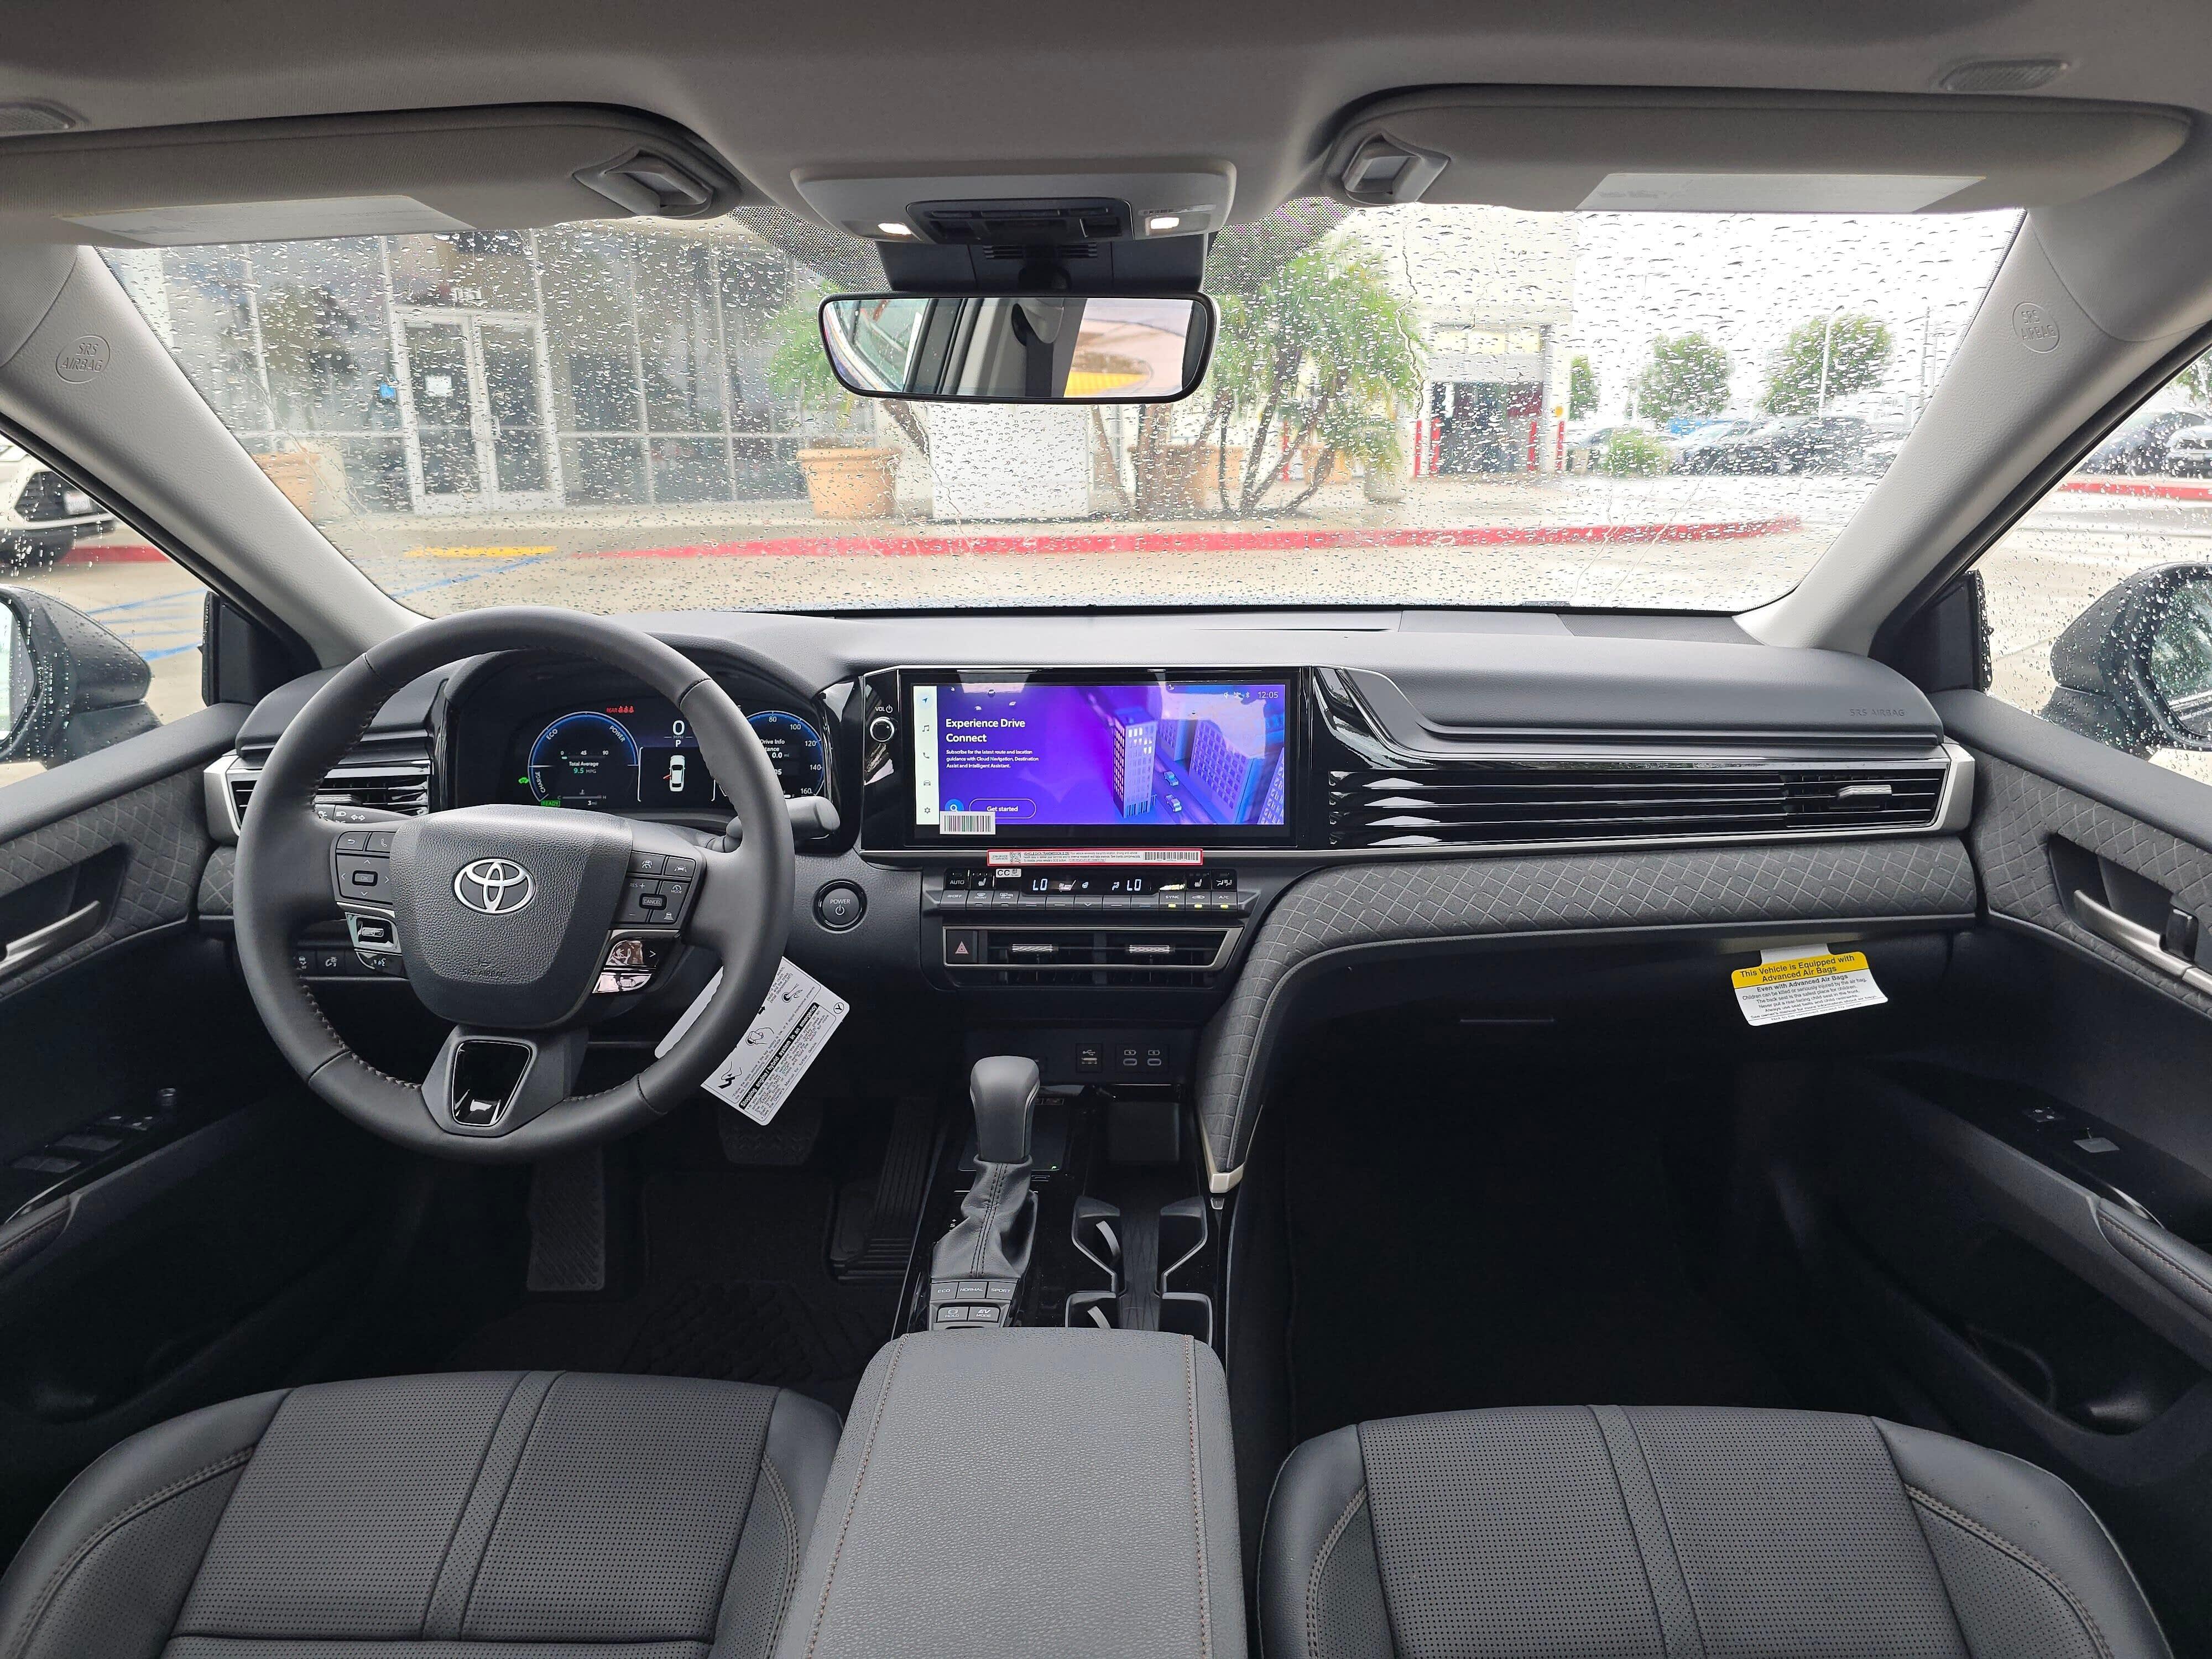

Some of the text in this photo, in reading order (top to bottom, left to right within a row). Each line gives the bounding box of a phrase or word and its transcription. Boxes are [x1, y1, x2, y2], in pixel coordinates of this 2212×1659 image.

[2021, 310, 2040, 325] SRS
[2021, 325, 2057, 341] AIRBAG
[76, 343, 98, 357] SRS
[59, 357, 103, 372] AIRBAG
[672, 720, 685, 735] 0
[946, 718, 1026, 729] Experience Drive
[546, 728, 557, 740] ECO
[609, 726, 625, 742] POWER
[946, 733, 987, 742] Connect
[535, 771, 545, 793] CHARGE
[1032, 878, 1048, 891] LO
[1126, 879, 1141, 891] LO
[1758, 965, 1787, 974] Vehicle
[1799, 957, 1835, 968] Equipped
[1762, 971, 1801, 982] Advanced
[1788, 978, 1819, 987] Advanced
[740, 1088, 757, 1107] Stopping
[766, 1056, 779, 1070] hybrid
[778, 1040, 791, 1056] system
[799, 1004, 817, 1026] emergency
[773, 1088, 784, 1101] Owner's
[784, 1073, 794, 1086] Manual
[799, 1055, 807, 1065] further
